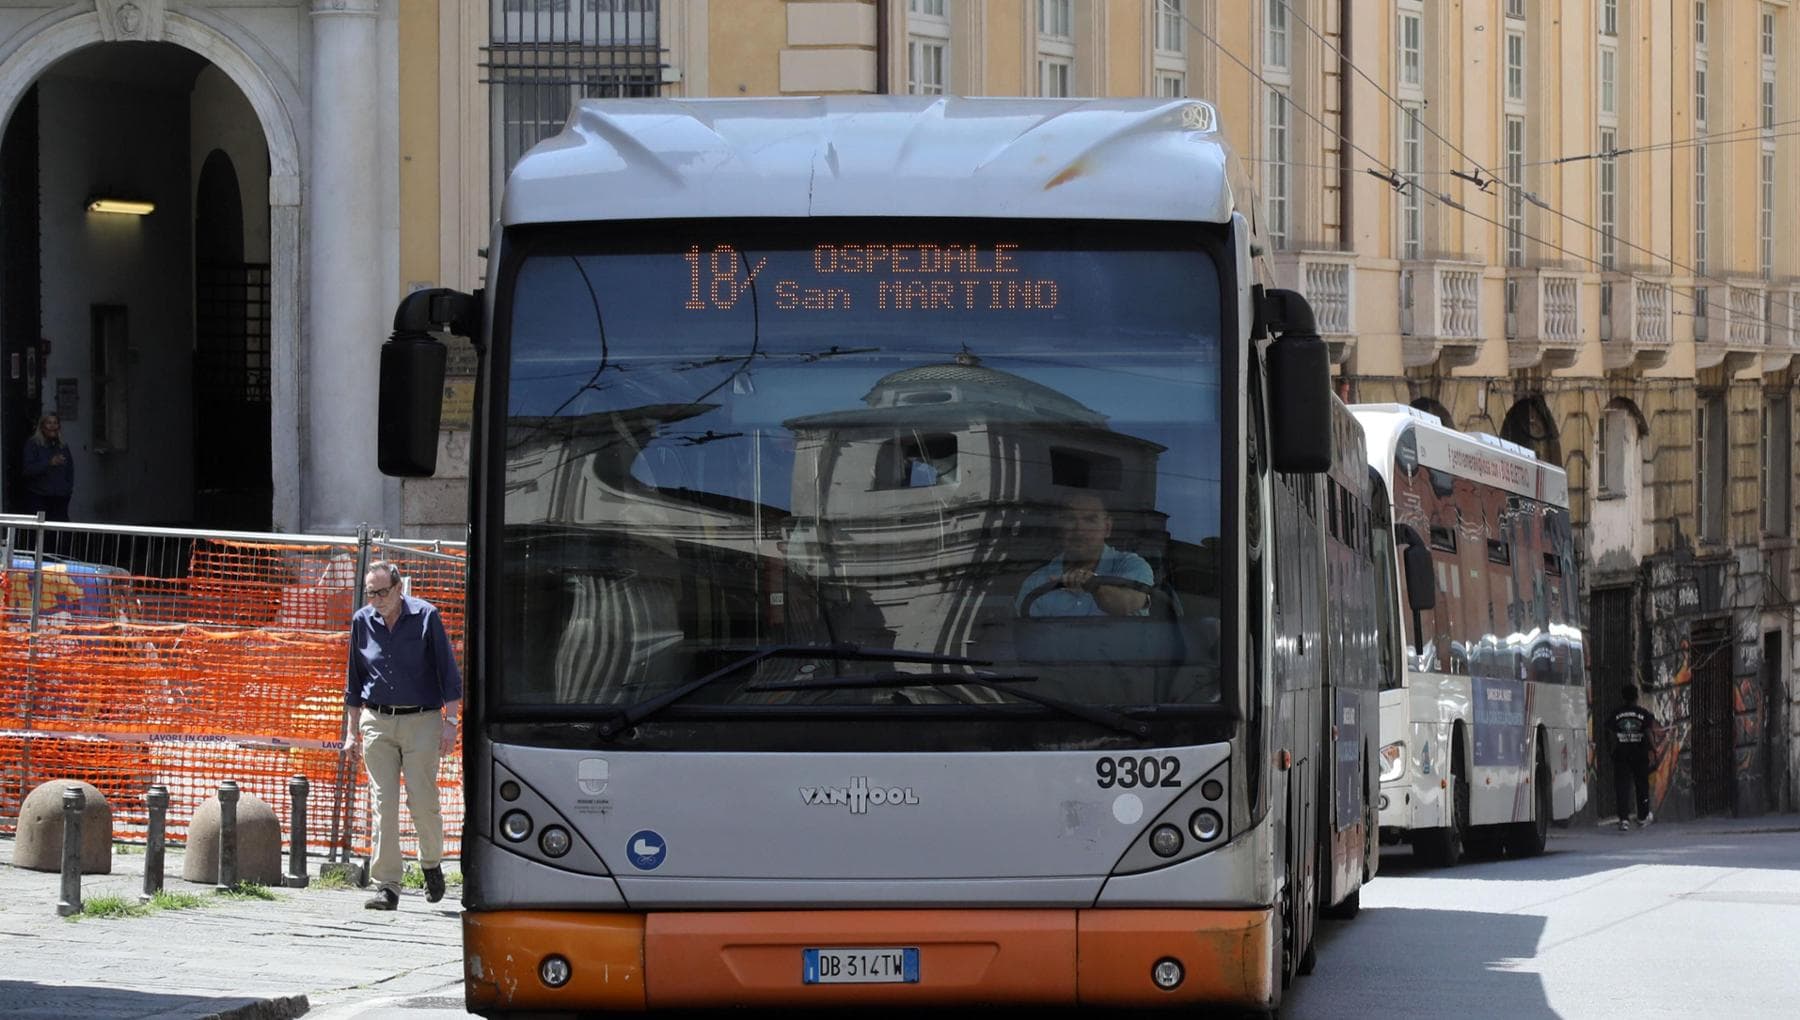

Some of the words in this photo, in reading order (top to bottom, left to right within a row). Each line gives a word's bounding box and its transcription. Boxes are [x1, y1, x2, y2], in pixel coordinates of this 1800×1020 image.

[813, 244, 1020, 273] OSPEDALE
[775, 280, 851, 310] San
[879, 280, 1058, 310] MARTINO
[322, 741, 343, 749] LAVO
[1096, 756, 1182, 789] 9302
[819, 955, 841, 976] DB
[847, 955, 903, 976] 314TW
